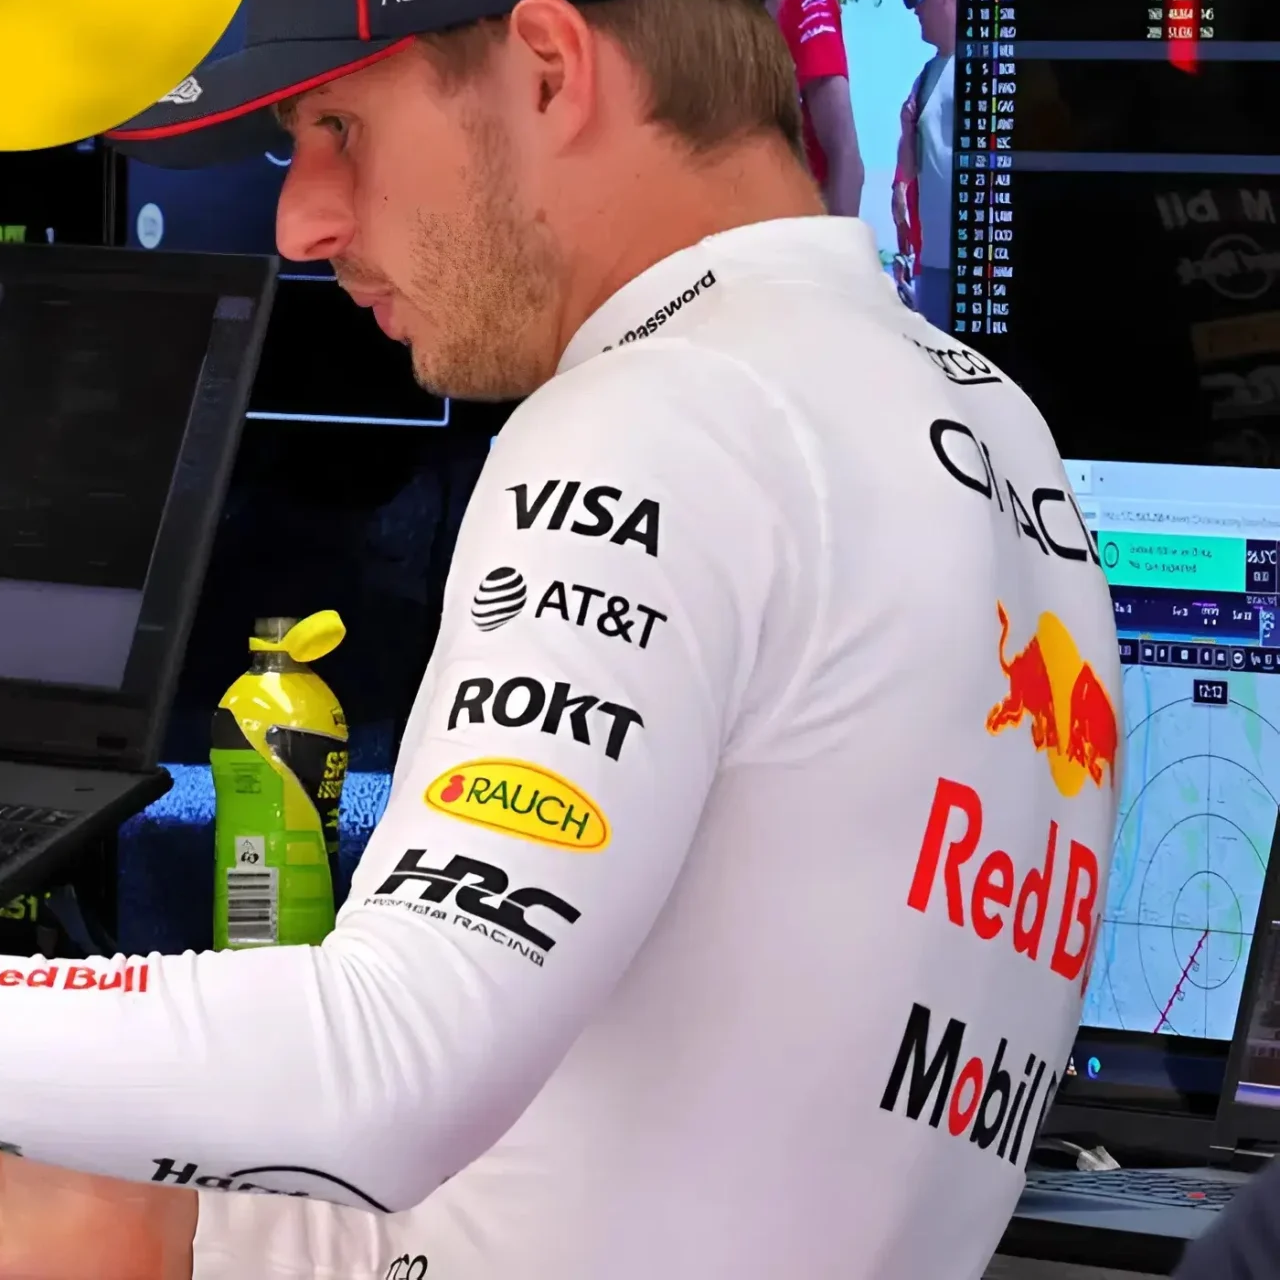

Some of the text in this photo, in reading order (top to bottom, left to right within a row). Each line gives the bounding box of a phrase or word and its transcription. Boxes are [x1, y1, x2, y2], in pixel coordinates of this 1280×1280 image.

[504, 479, 661, 558] VISA
[534, 580, 668, 650] AT&T
[447, 676, 645, 762] ROKT
[465, 776, 590, 840] RAUCH
[373, 848, 583, 953] HRC
[907, 776, 1059, 962] Red
[63, 964, 149, 994] Bull
[452, 914, 545, 968] RACING
[879, 1002, 1048, 1173] Mobil
